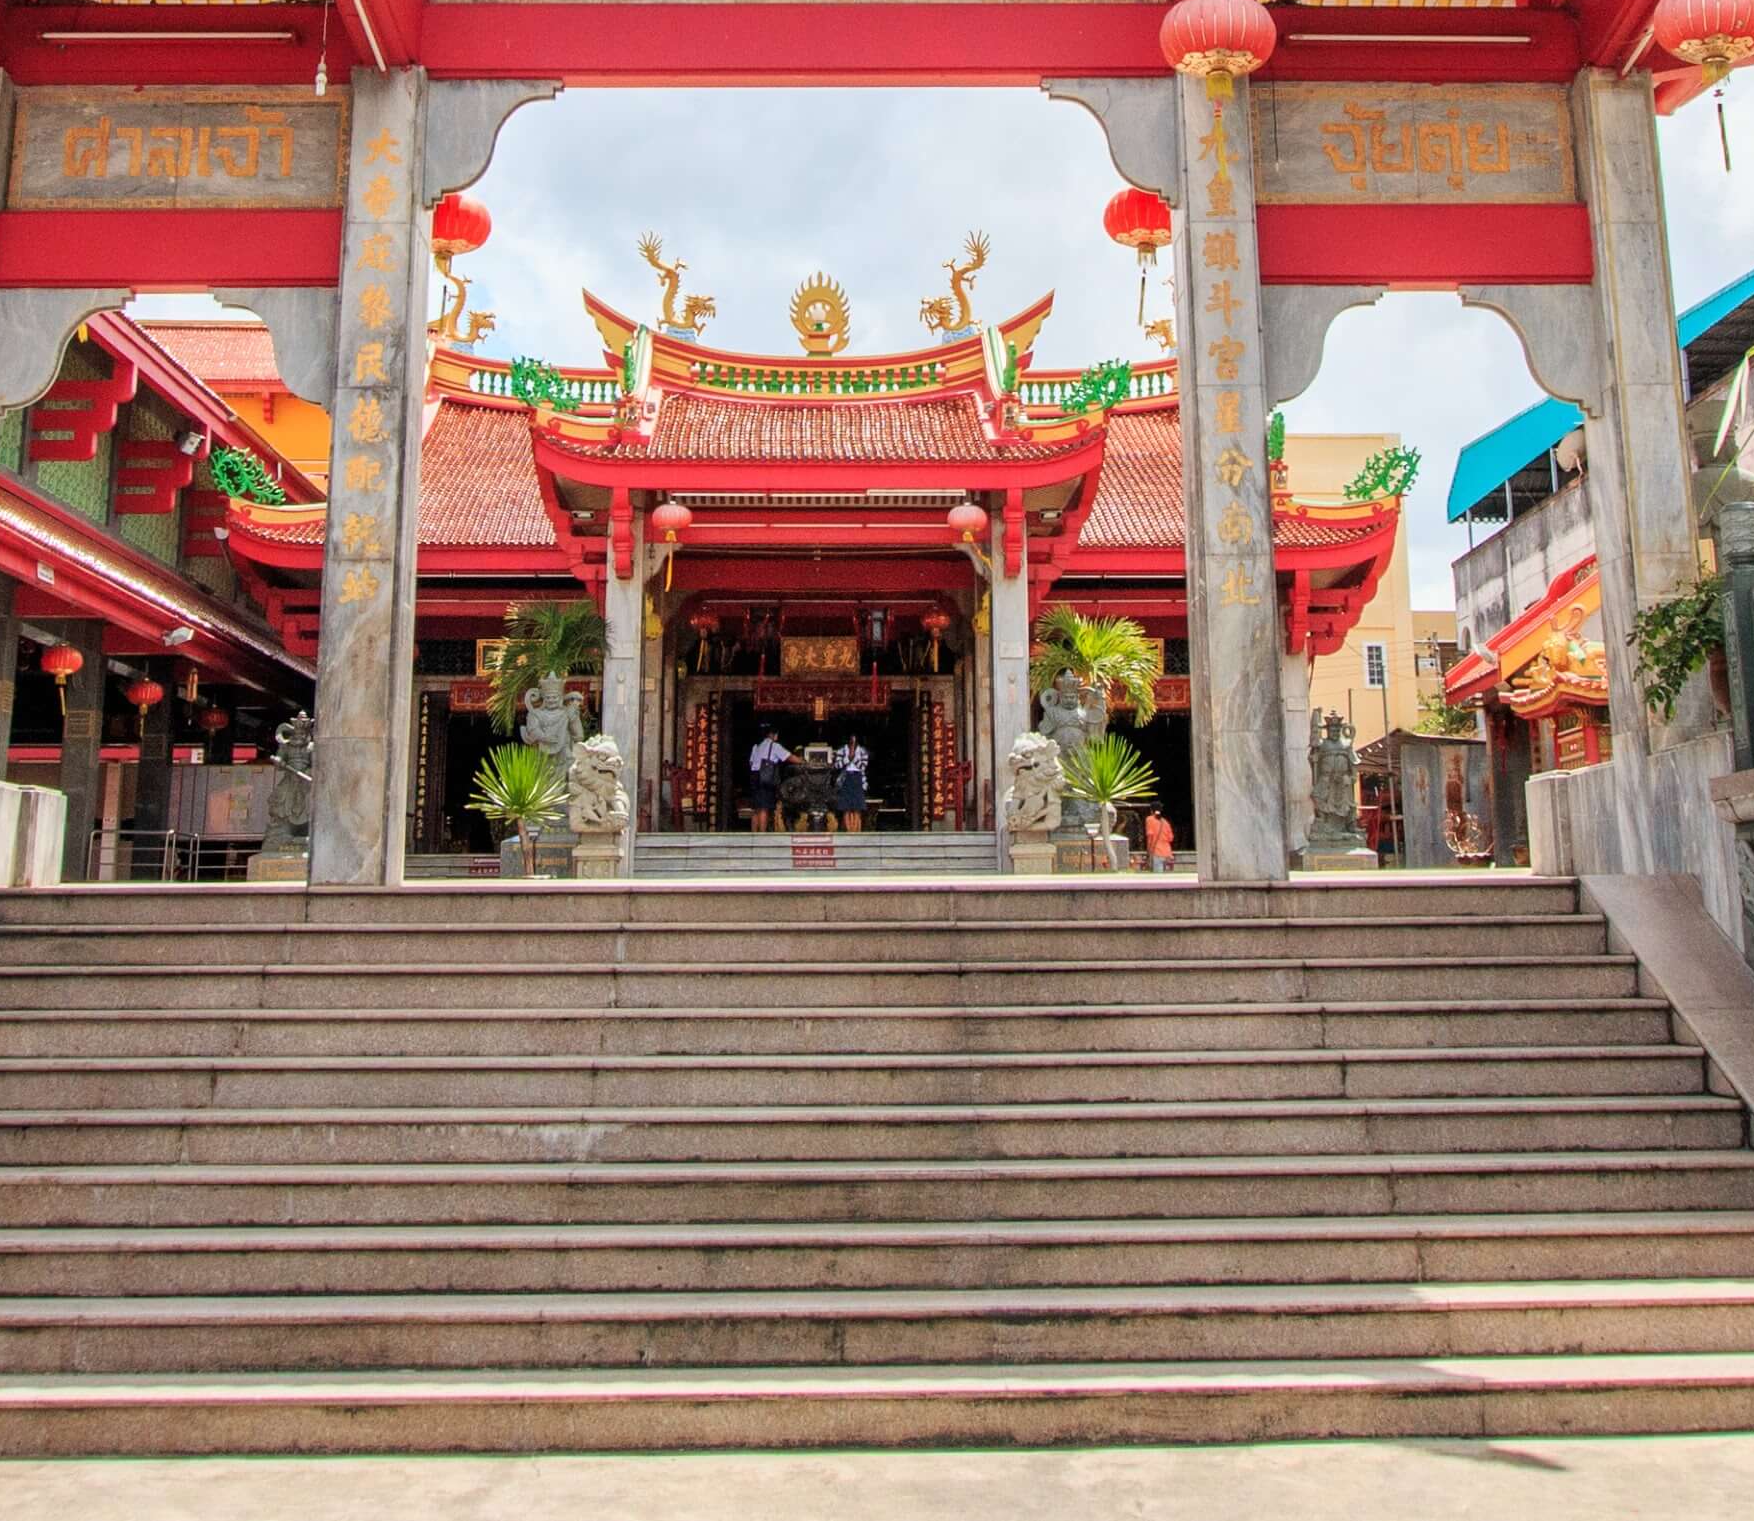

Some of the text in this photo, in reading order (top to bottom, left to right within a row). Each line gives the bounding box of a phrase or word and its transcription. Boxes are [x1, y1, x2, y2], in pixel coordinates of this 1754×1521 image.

[63, 106, 294, 177] ศาลเจ้า
[1320, 101, 1510, 192] จุ้ยตุ่ย
